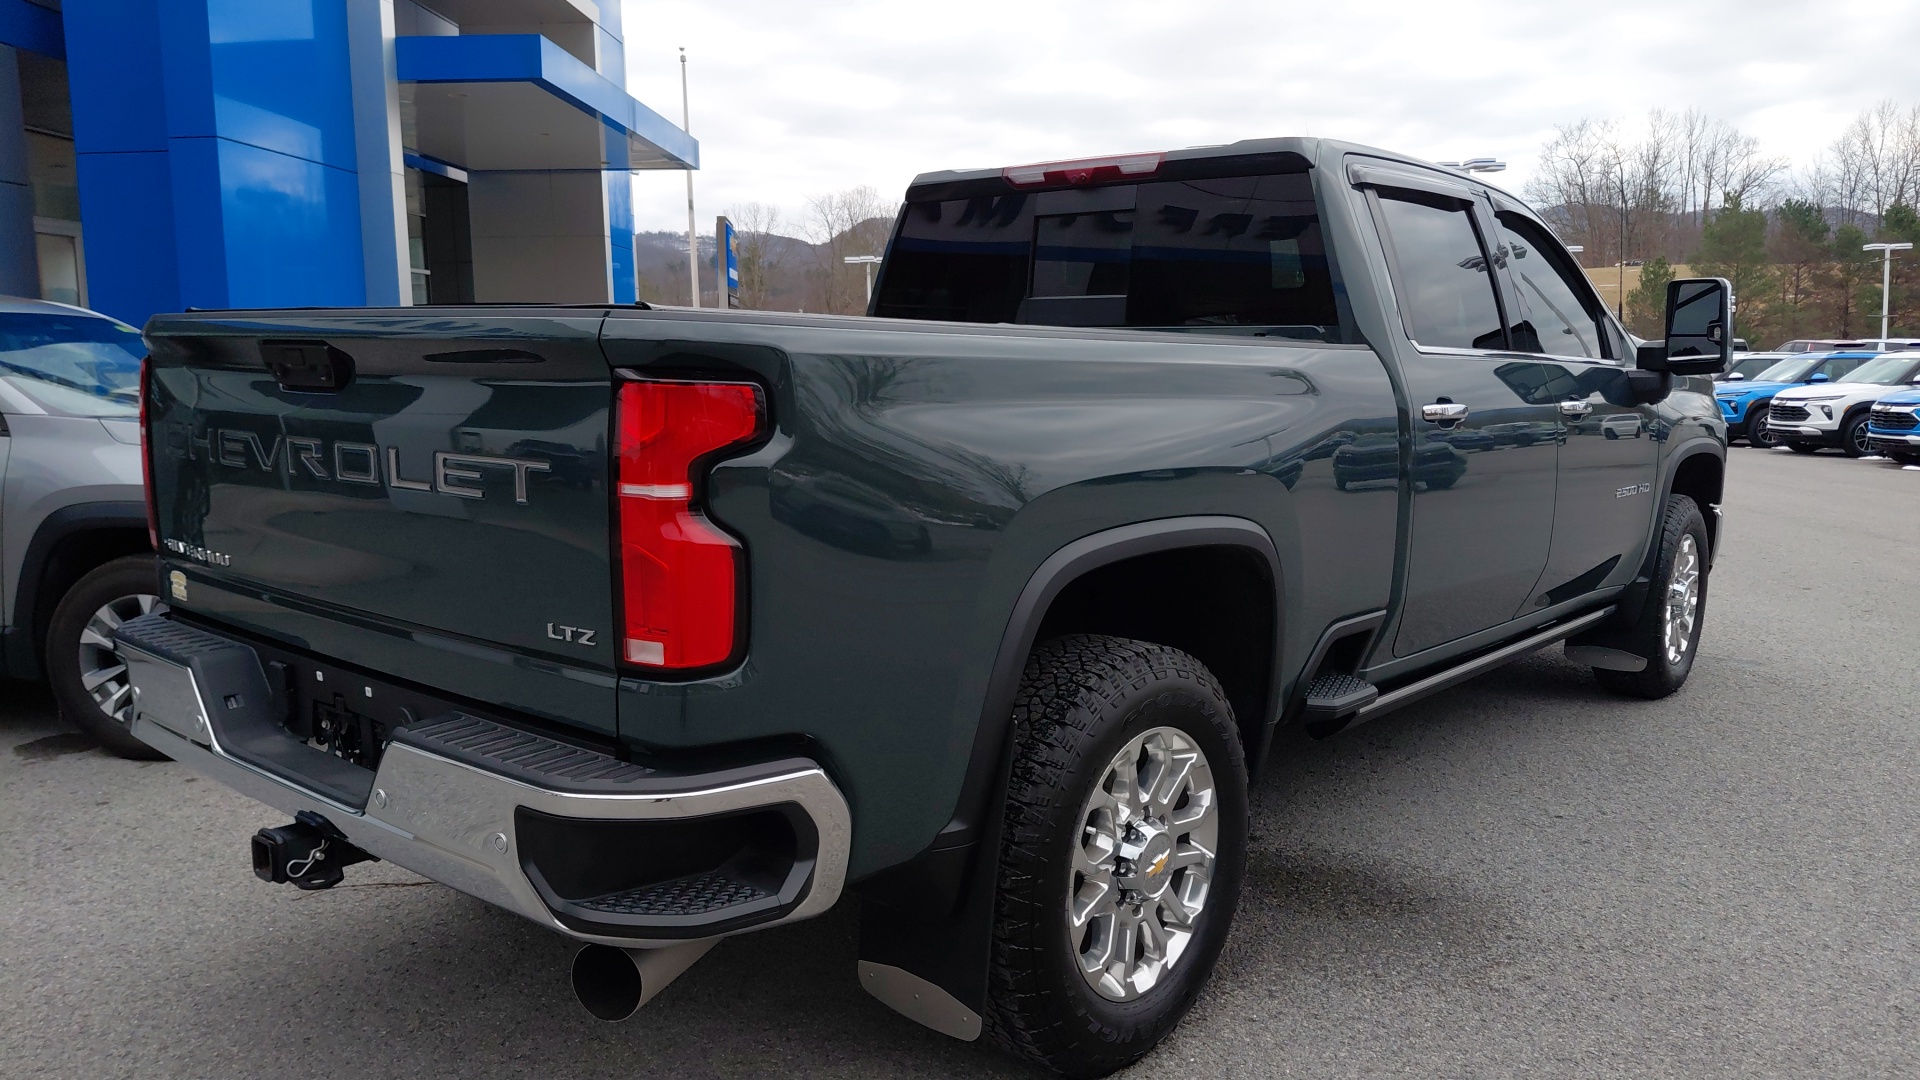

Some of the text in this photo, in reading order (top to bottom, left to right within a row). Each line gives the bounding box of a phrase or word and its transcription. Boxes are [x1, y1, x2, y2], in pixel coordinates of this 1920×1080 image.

[165, 422, 551, 504] CHEVROLET
[1615, 483, 1650, 498] 2500 HD
[547, 622, 597, 646] LTZ
